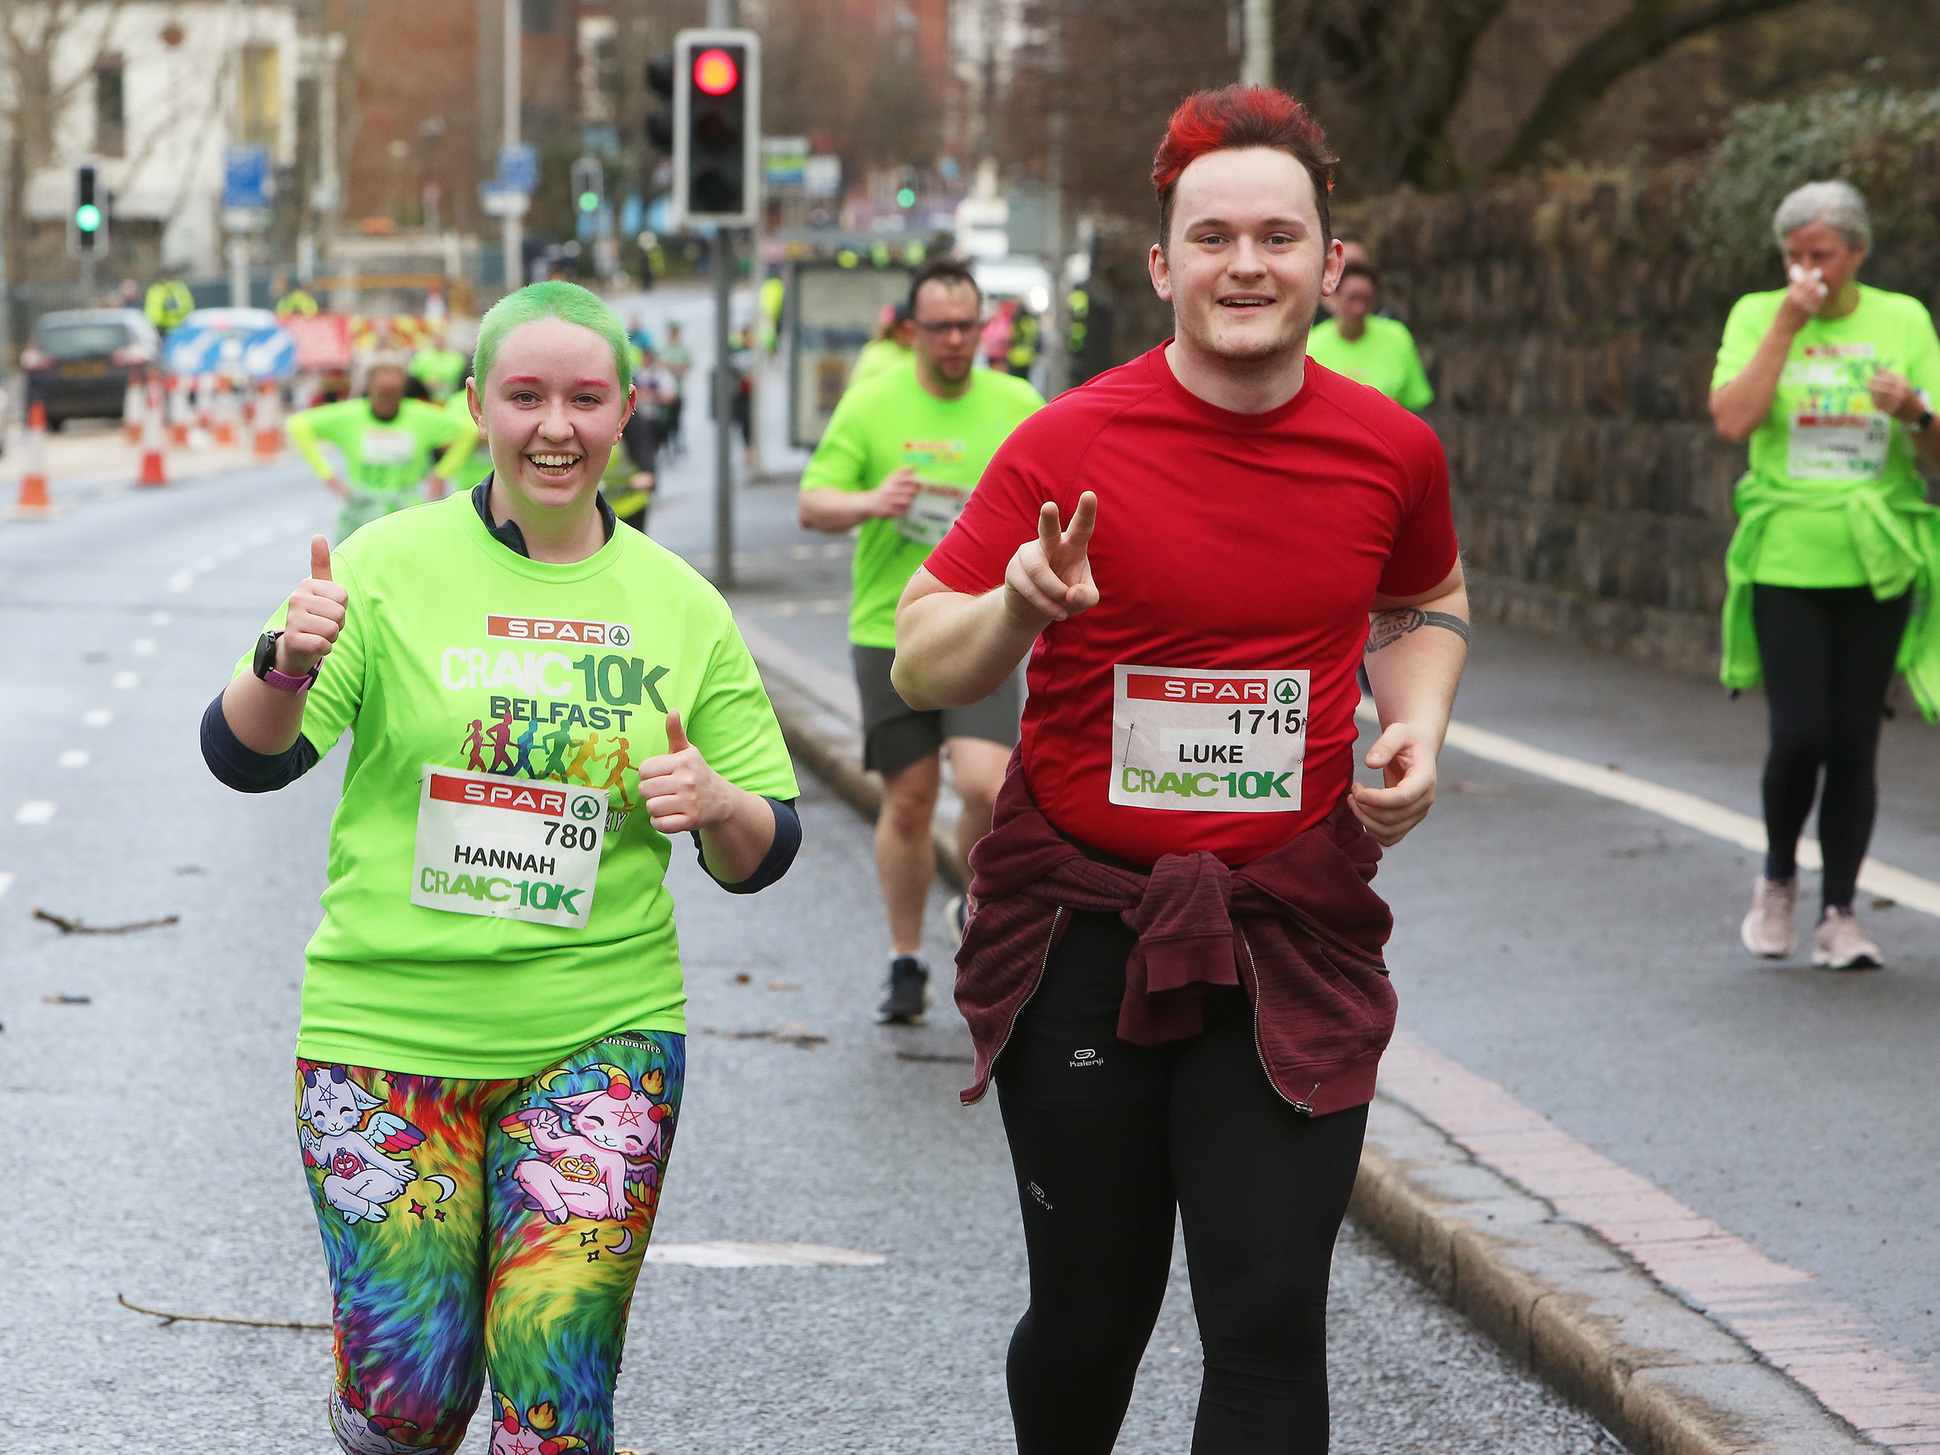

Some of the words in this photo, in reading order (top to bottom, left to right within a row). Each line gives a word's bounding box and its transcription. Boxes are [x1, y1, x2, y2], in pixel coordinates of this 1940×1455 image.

[507, 620, 604, 643] SPAR
[1164, 680, 1266, 700] SPAR
[490, 696, 633, 732] BELFAST
[1228, 709, 1301, 735] 1715
[1178, 744, 1244, 764] LUKE
[464, 783, 564, 813] SPAR
[543, 820, 597, 852] 780
[454, 845, 556, 876] HANNAH
[1069, 1057, 1104, 1068] Kalenji
